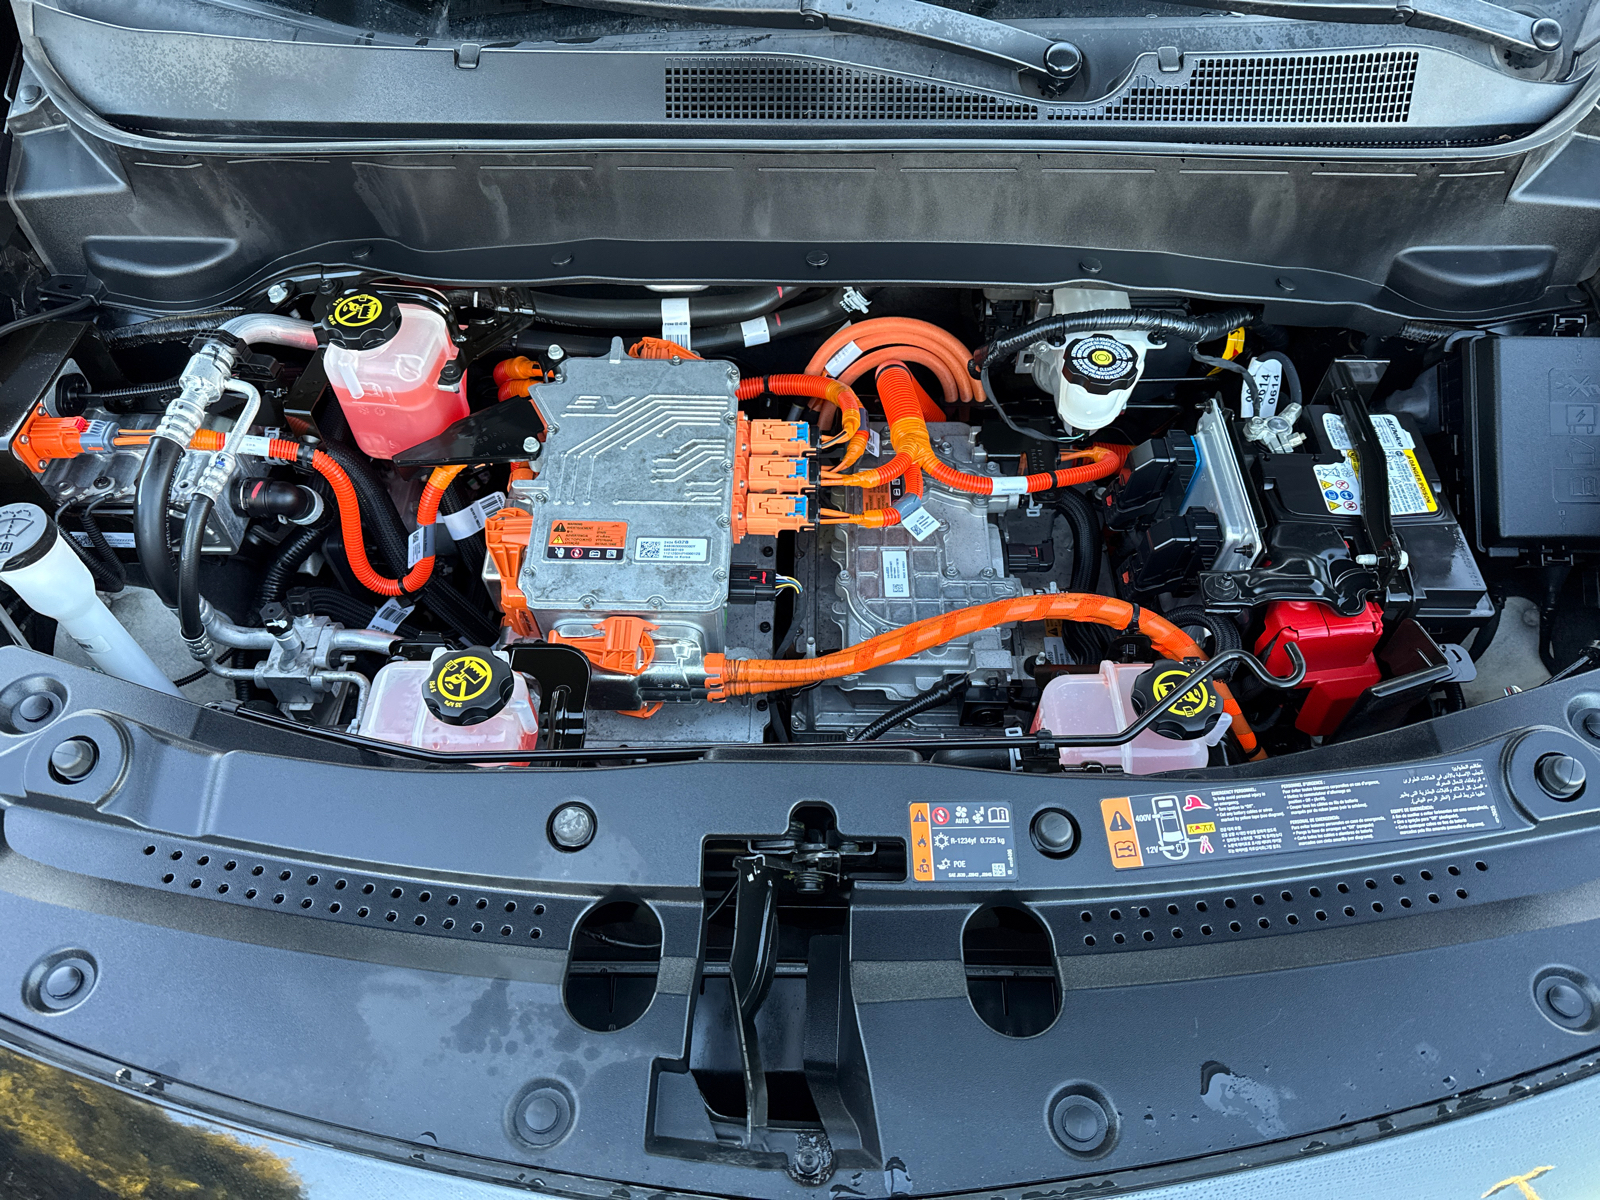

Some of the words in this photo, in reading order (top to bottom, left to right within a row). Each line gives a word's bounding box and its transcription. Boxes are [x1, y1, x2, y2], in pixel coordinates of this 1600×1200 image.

[1268, 375, 1280, 404] 0614
[1386, 418, 1404, 448] ACDelco
[1408, 459, 1422, 484] DANGER
[1420, 484, 1432, 504] POISON
[997, 837, 1005, 845] kg
